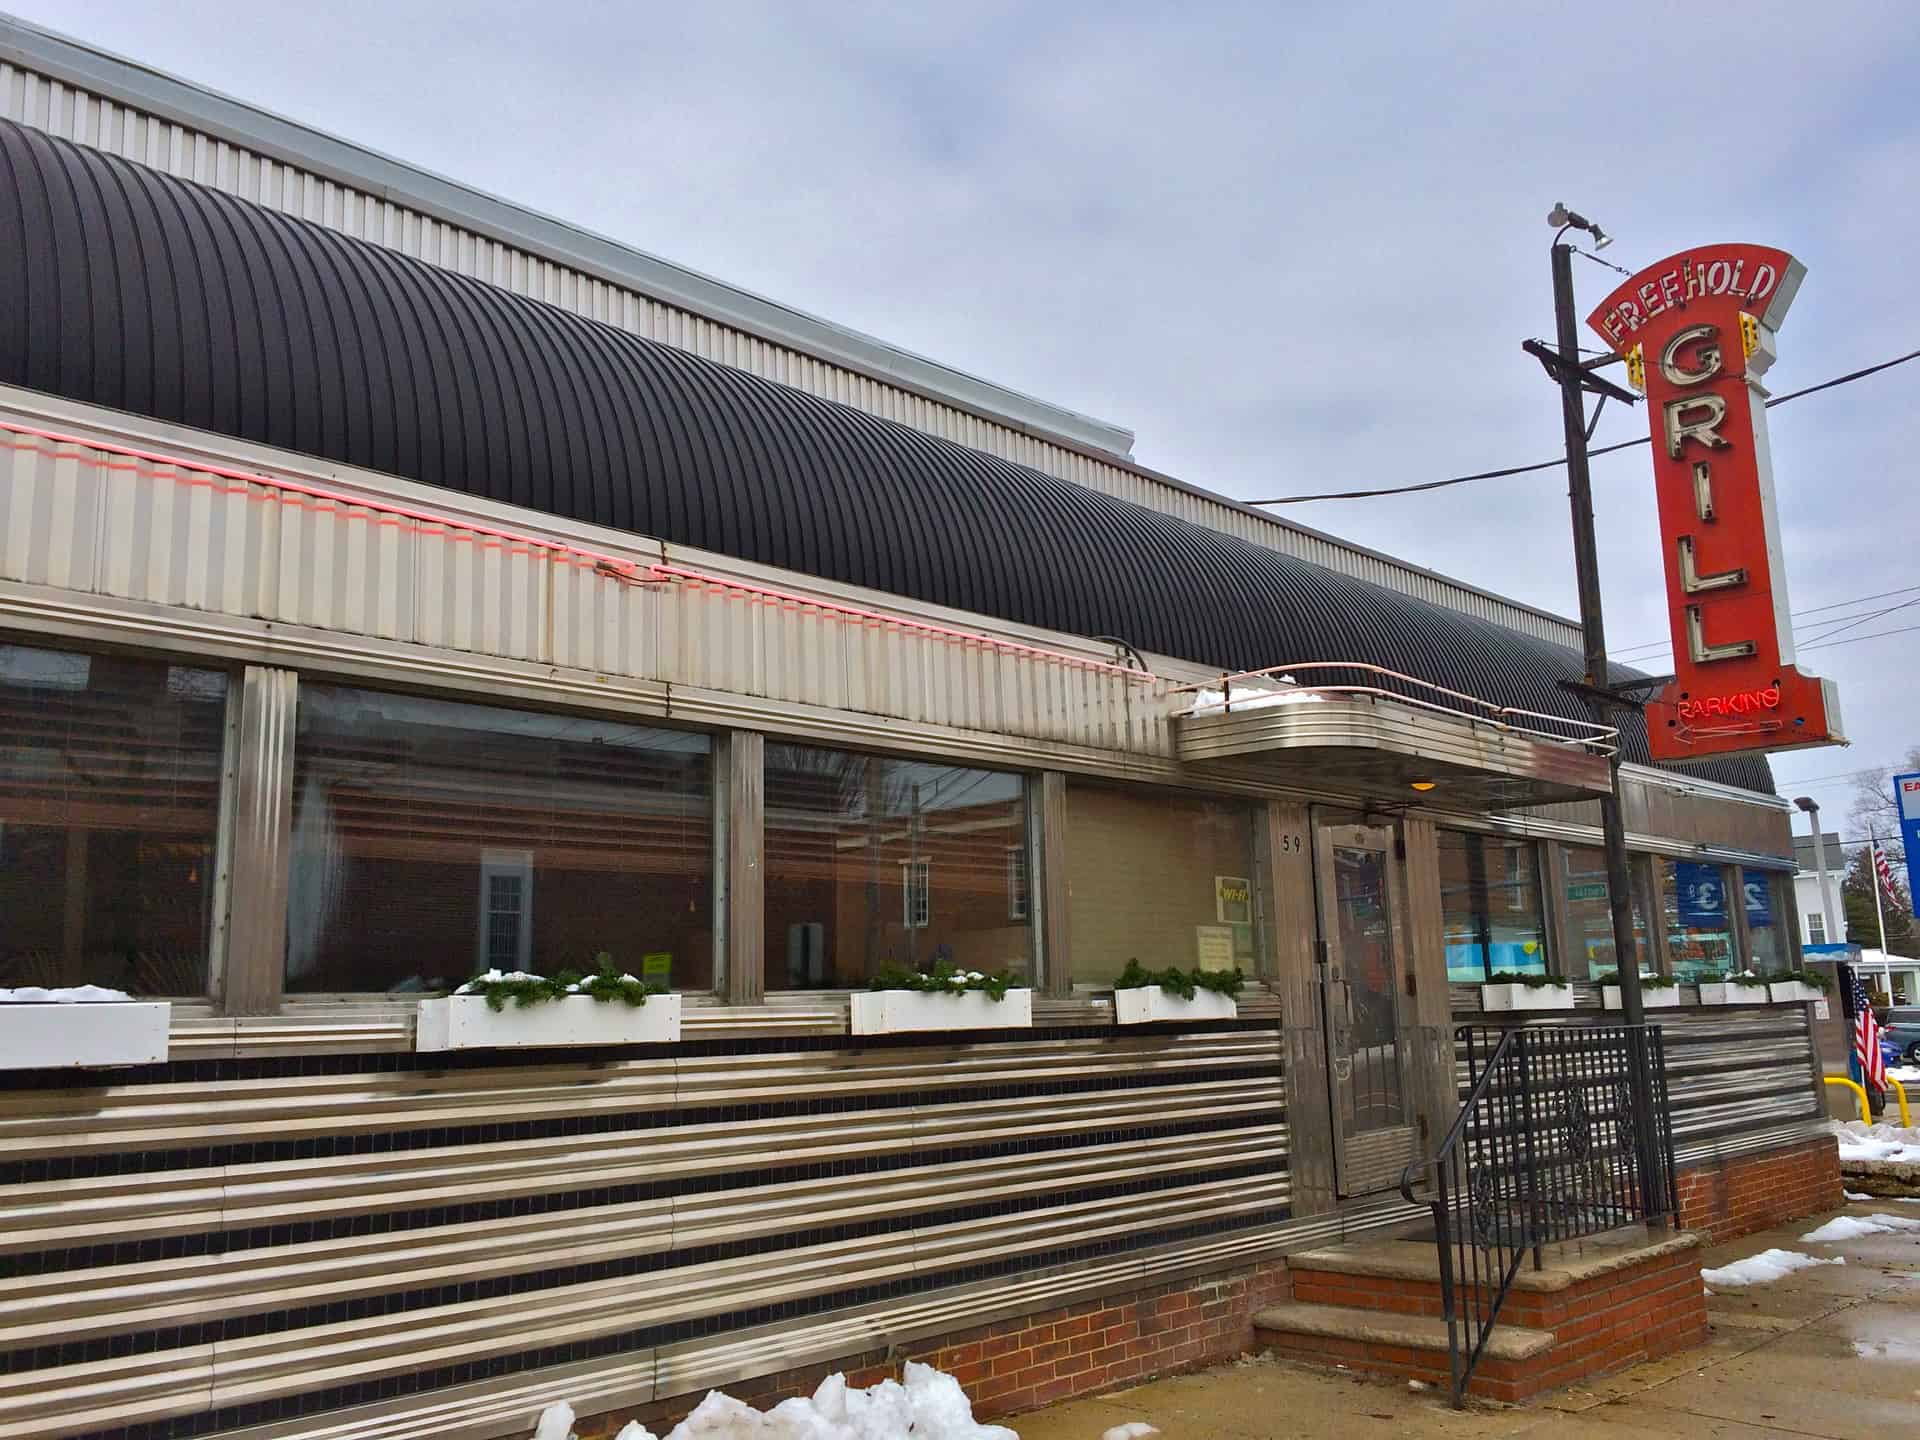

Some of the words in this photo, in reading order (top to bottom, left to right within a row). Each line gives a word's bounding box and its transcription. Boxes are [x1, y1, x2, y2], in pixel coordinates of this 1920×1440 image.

[1601, 258, 1776, 346] FREEHOLD
[1659, 322, 1757, 663] GRILL
[1677, 688, 1780, 718] PARKING
